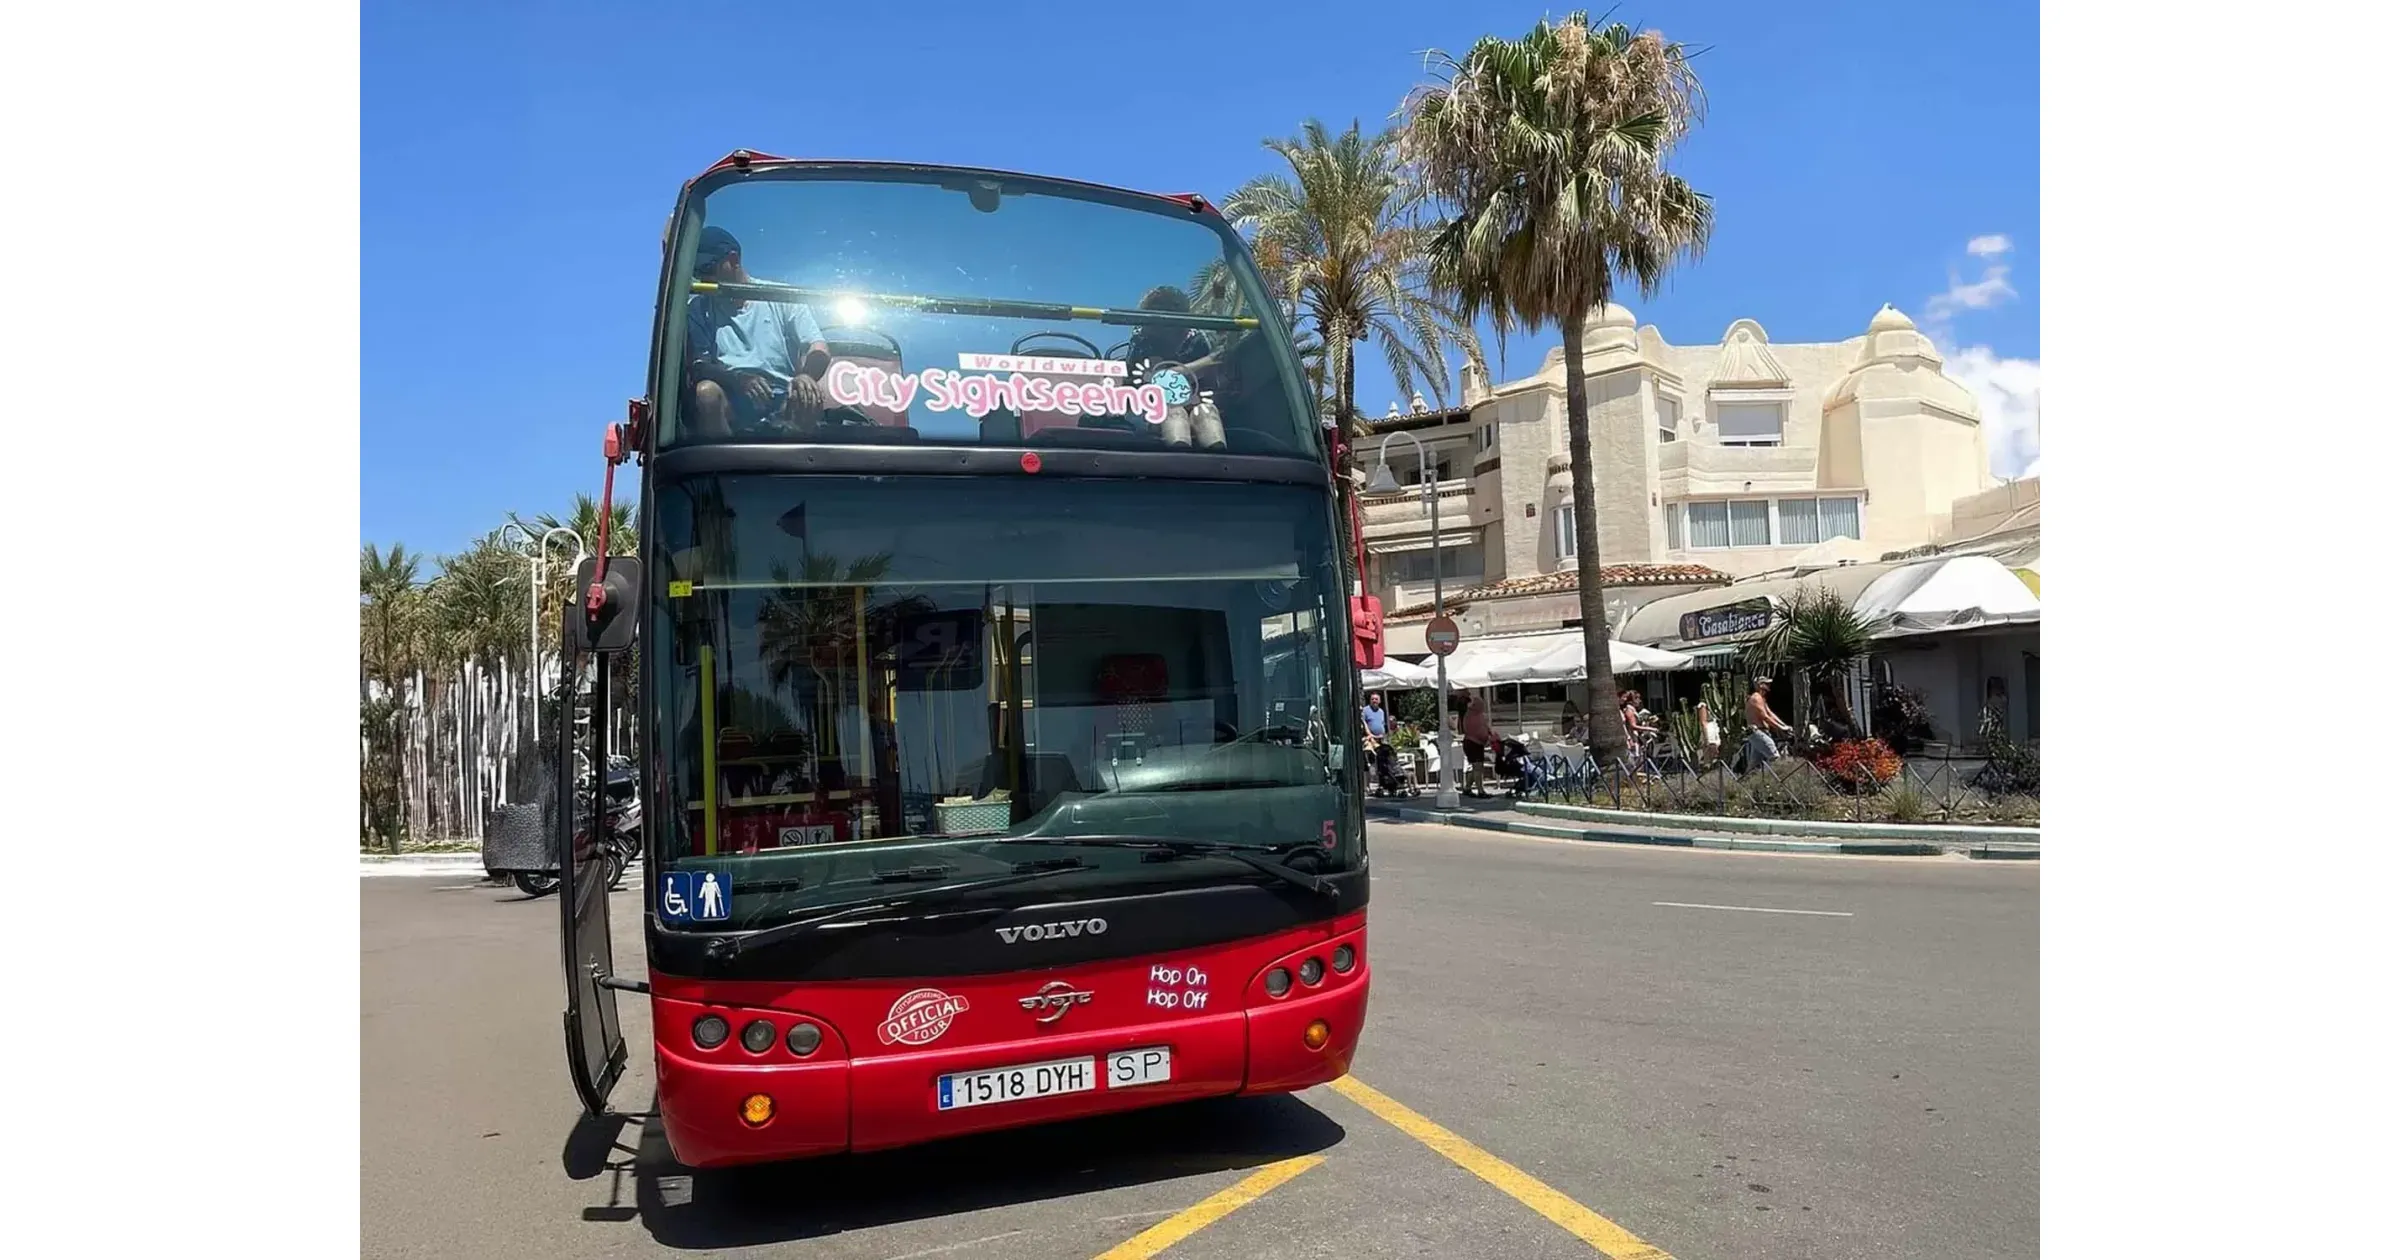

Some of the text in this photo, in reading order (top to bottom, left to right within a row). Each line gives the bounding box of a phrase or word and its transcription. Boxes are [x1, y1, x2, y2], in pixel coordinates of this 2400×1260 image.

[974, 355, 1123, 375] Worldwide
[828, 361, 1168, 425] City Sightseeing
[1322, 820, 1337, 849] 5
[996, 918, 1107, 943] VOLVO
[1150, 965, 1207, 985] Hop On
[1147, 989, 1209, 1008] Hop Off
[887, 998, 964, 1037] OFFICIAL
[914, 1020, 947, 1040] TOUR
[964, 1064, 1083, 1102] 1518 DYH
